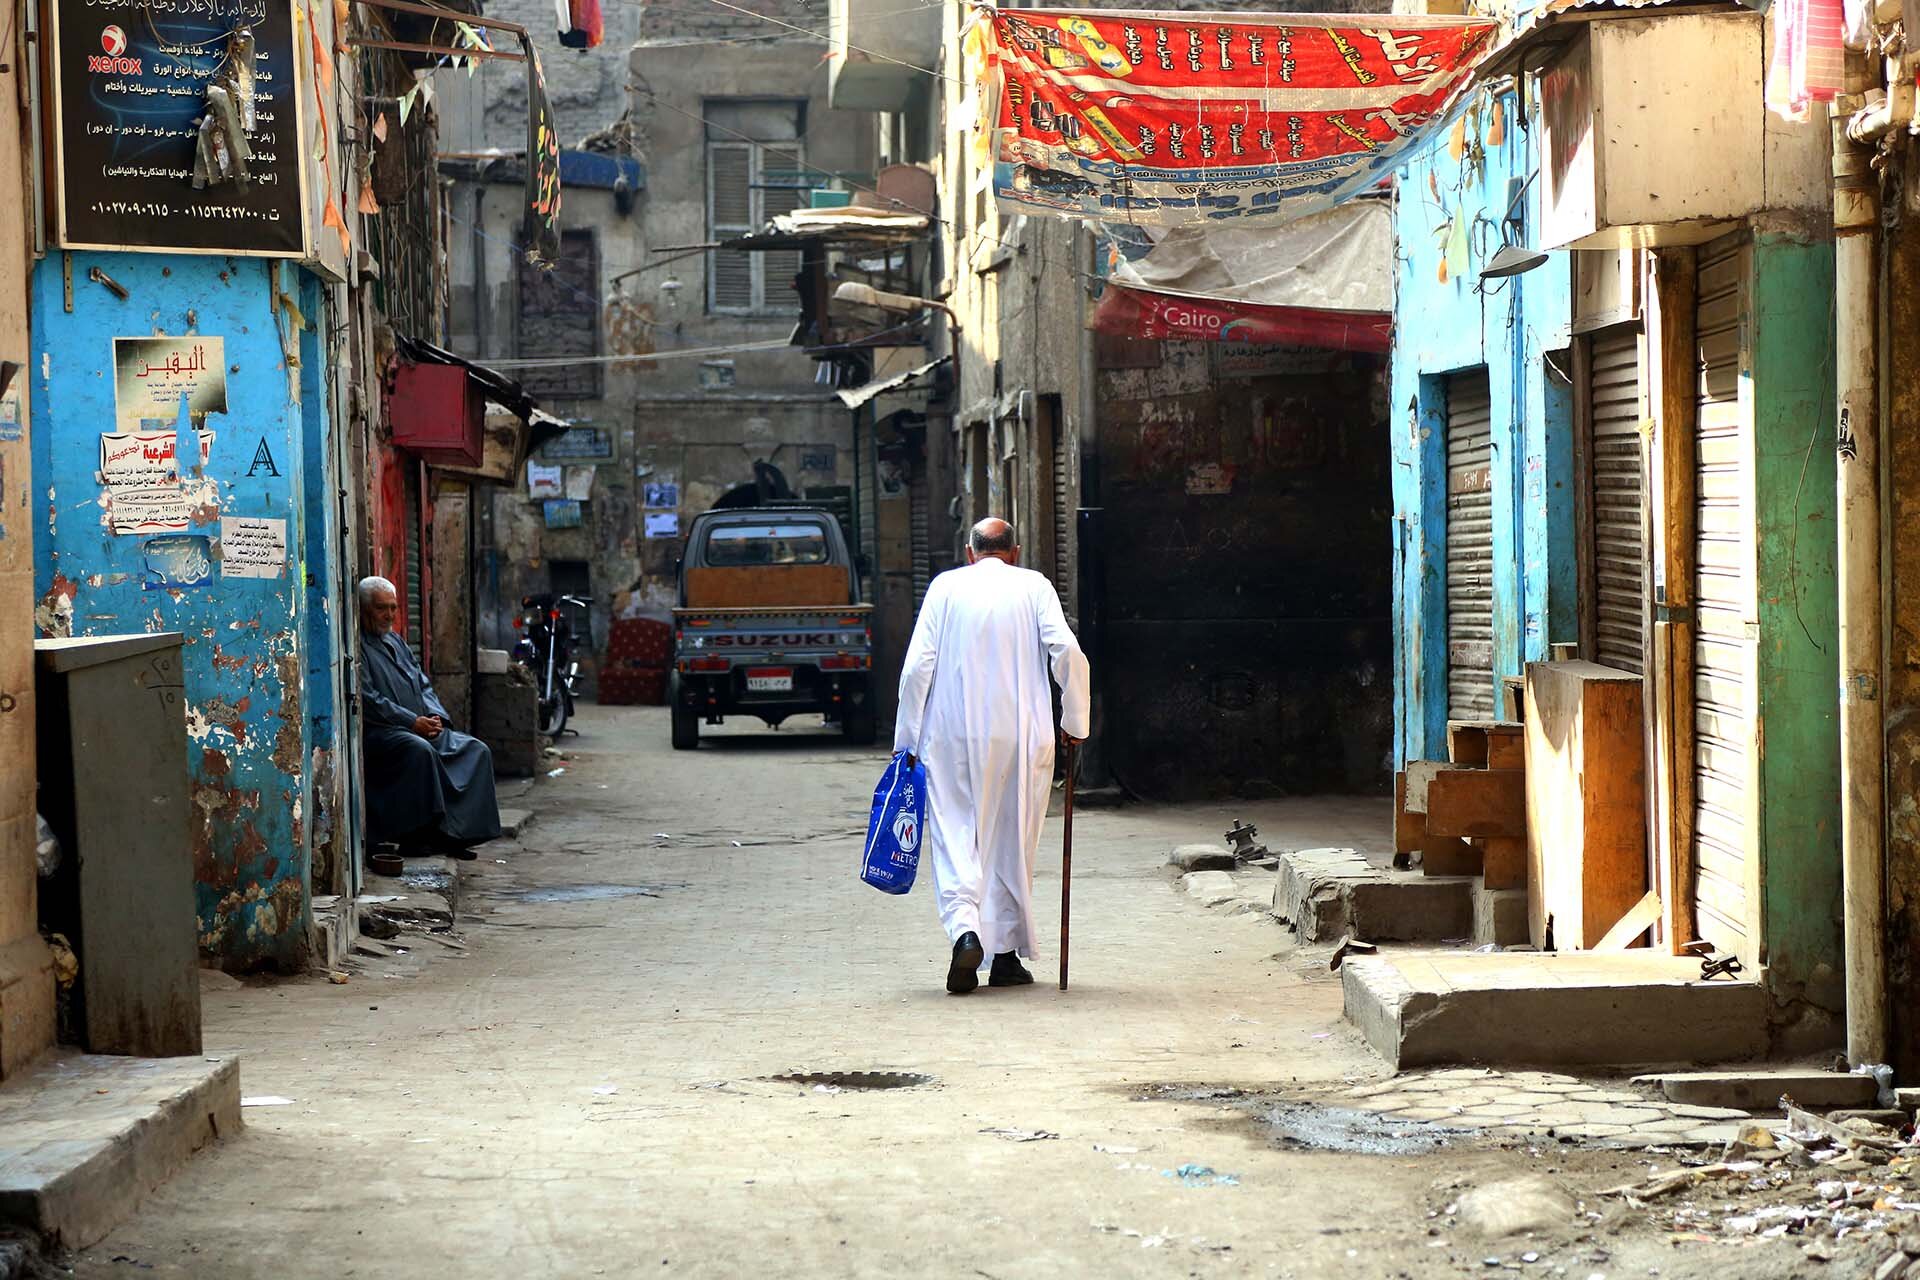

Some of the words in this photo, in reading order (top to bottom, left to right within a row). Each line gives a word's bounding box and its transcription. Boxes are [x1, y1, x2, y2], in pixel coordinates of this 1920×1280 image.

[88, 55, 142, 75] xerox
[153, 63, 173, 77] الورق
[105, 79, 127, 94] وأختام
[167, 85, 192, 97] شخصية
[256, 111, 274, 121] طباعة
[258, 152, 277, 162] طباعة
[139, 167, 166, 178] التذكارية
[1164, 307, 1221, 328] Cairo
[143, 442, 176, 465] الشرعية
[246, 436, 281, 477] A
[715, 634, 834, 646] SUZUKI
[891, 851, 918, 866] METRO
